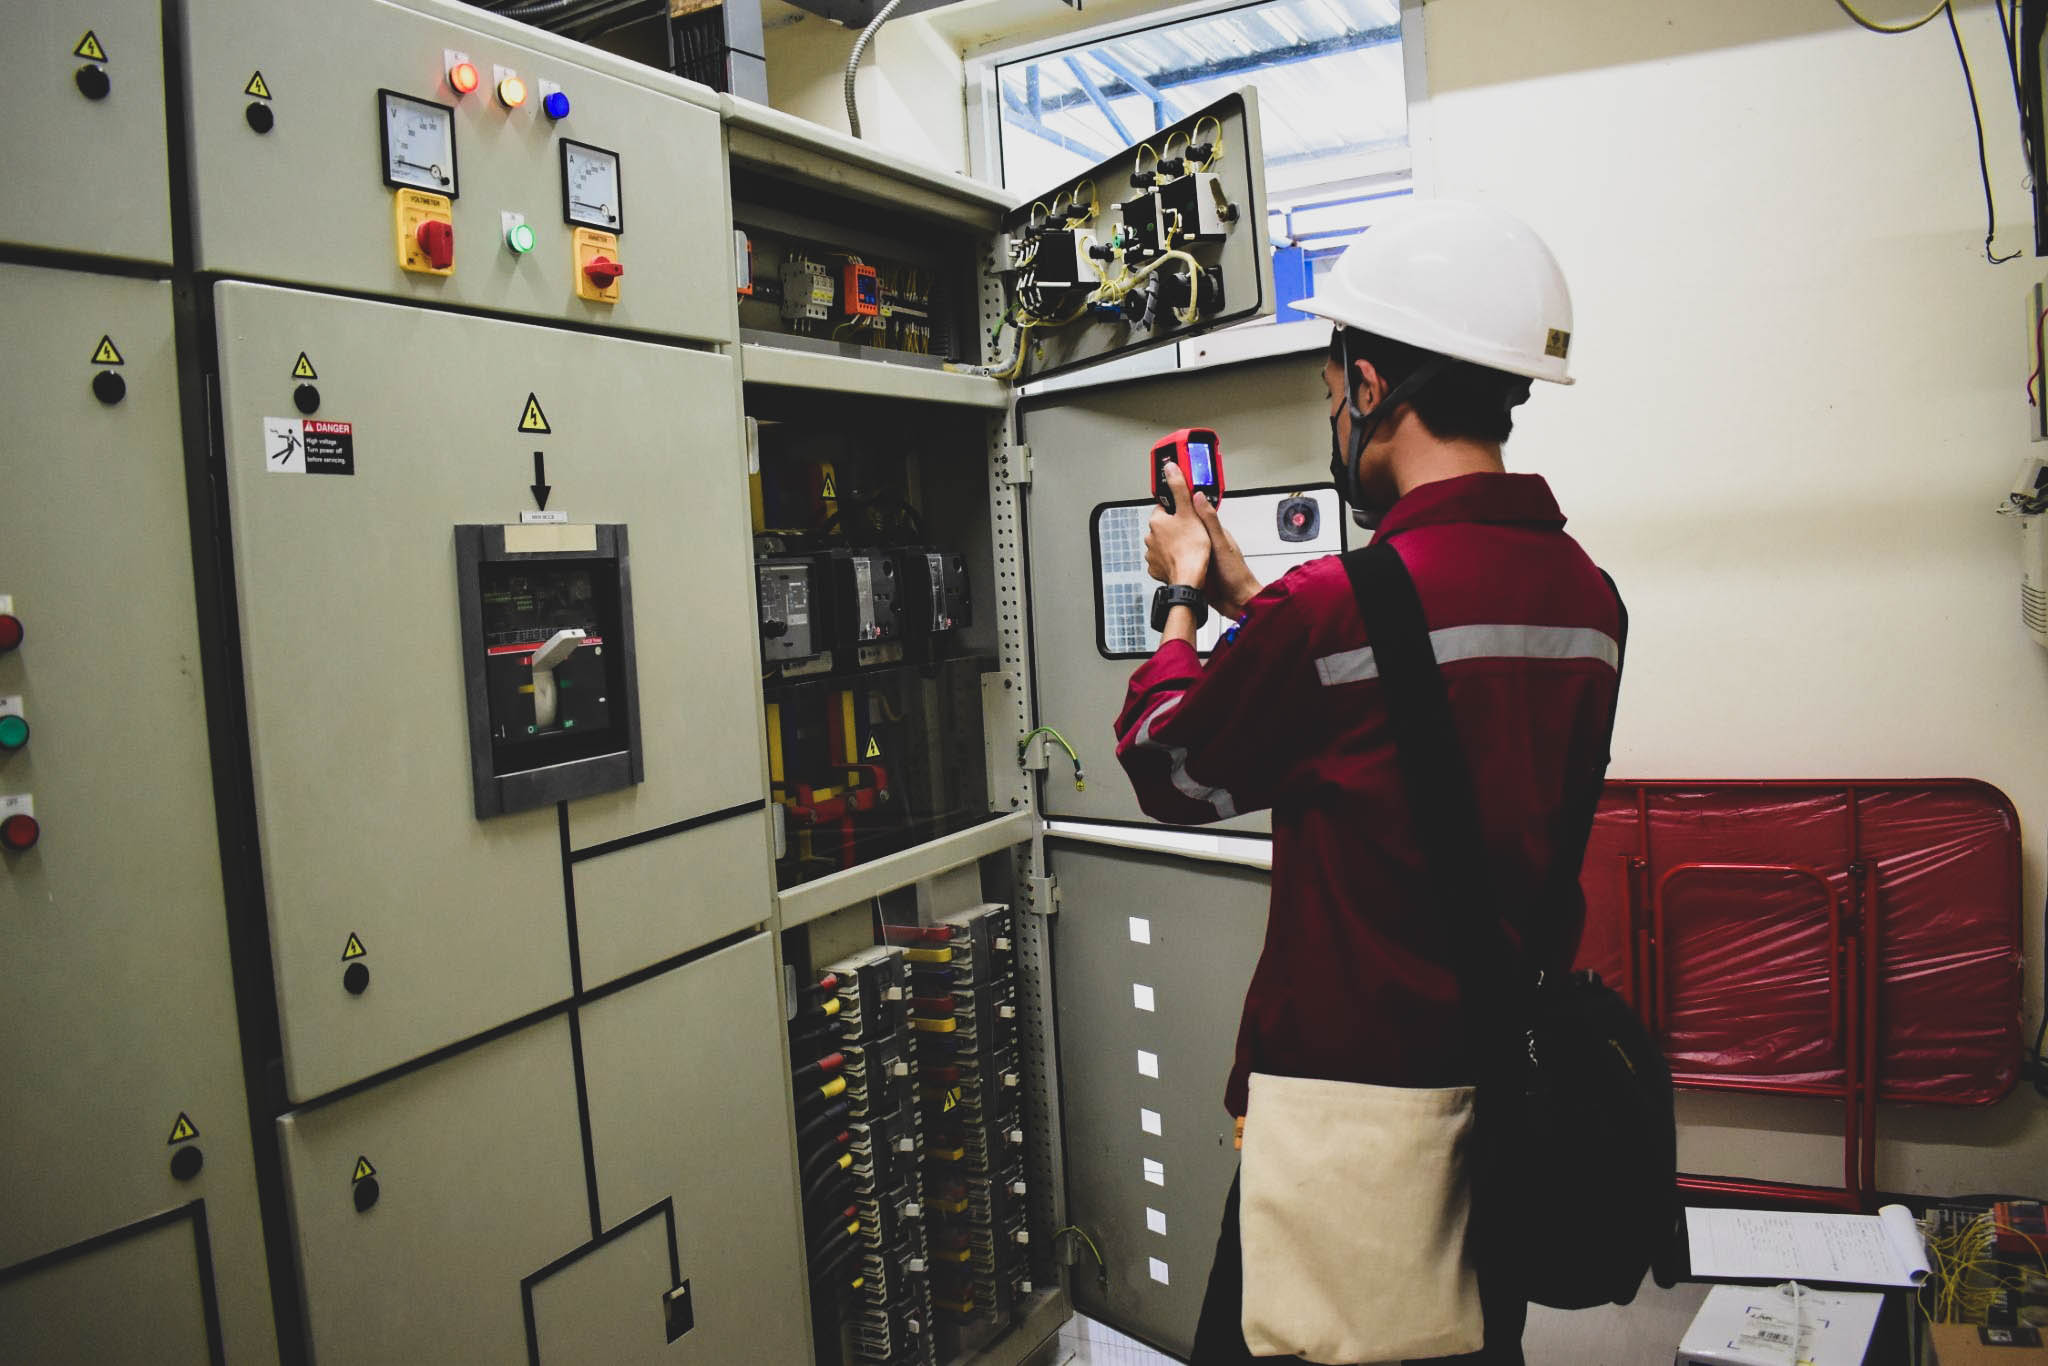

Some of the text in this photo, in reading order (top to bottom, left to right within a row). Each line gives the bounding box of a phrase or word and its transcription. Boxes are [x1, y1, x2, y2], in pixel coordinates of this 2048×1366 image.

[391, 107, 397, 118] V
[569, 154, 575, 164] A
[410, 196, 440, 206] VOLTMETER
[316, 423, 350, 432] DANGER
